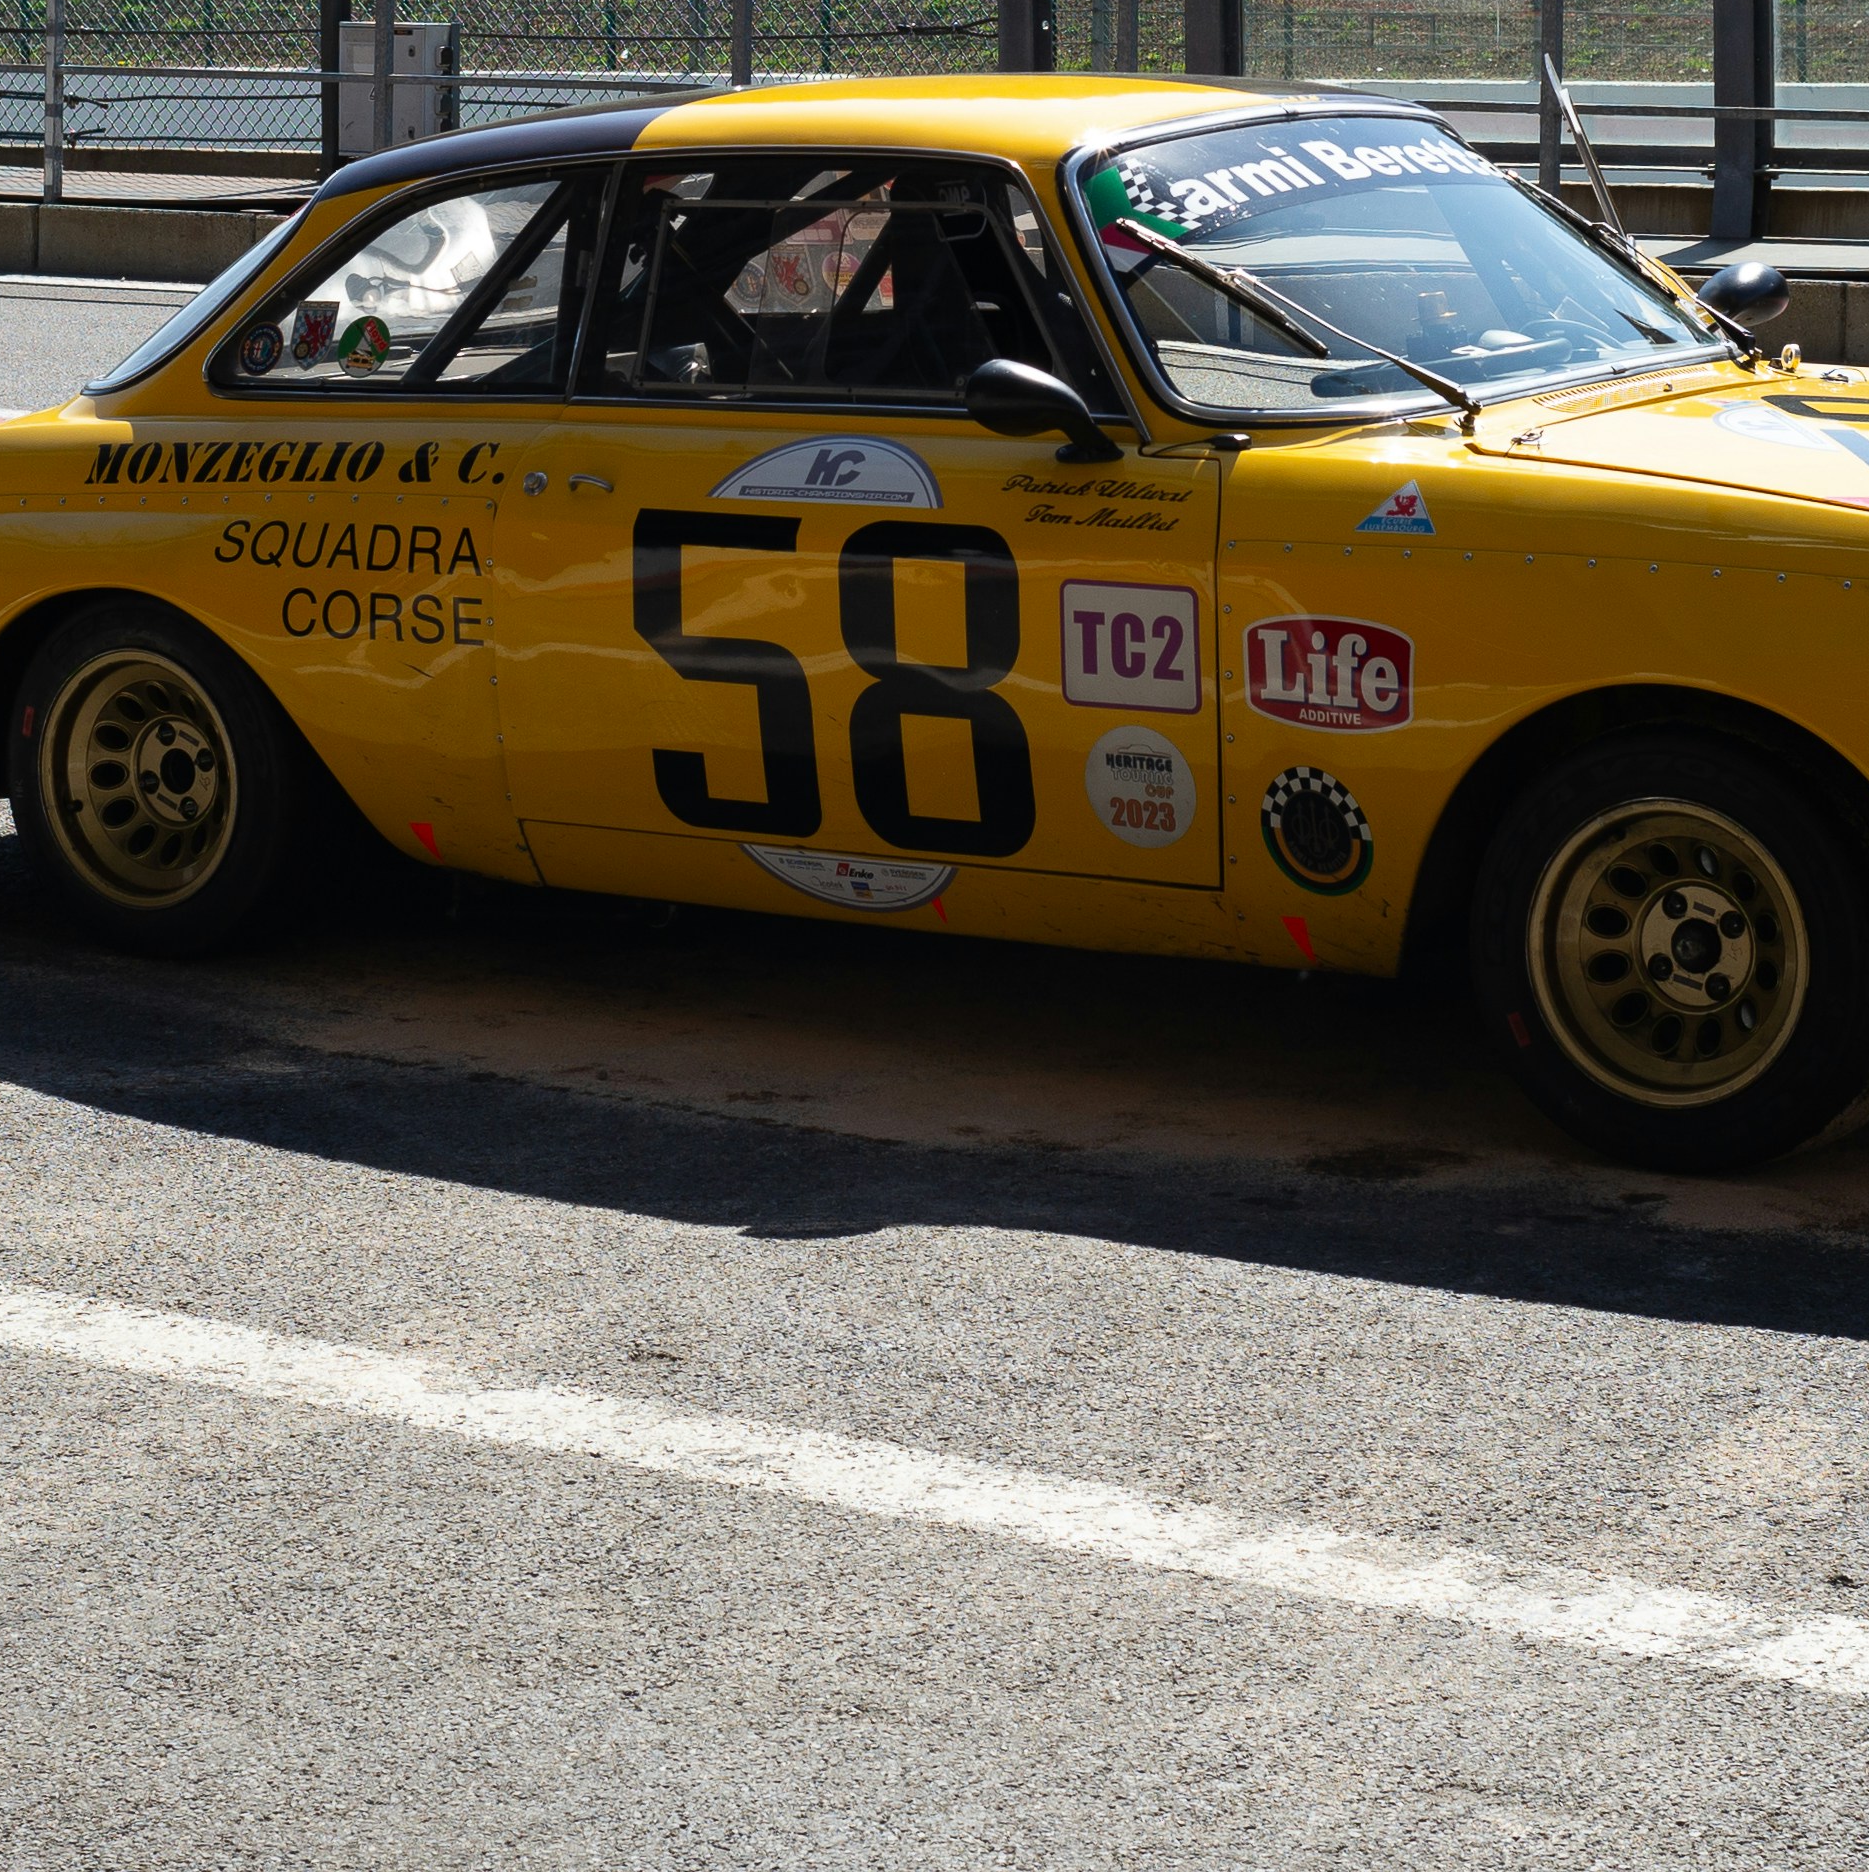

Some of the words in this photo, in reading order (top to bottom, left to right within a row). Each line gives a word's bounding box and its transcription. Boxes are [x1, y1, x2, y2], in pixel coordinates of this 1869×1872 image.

[1168, 146, 1326, 218] armi
[1298, 137, 1506, 183] Beretta
[84, 440, 385, 485] MONZEGLIO
[398, 440, 439, 485] &
[457, 441, 507, 486] C.
[744, 486, 910, 502] HISTORIC-CHAMPIONSHIP.COM
[1001, 473, 1096, 497] Patrick
[1024, 503, 1073, 523] Tom
[213, 519, 485, 577] SQUADRA
[281, 587, 486, 647] CORSE
[1073, 609, 1185, 682] TC2
[631, 508, 1036, 858] 58
[1257, 628, 1400, 713] Life
[1298, 707, 1363, 726] ADDITIVE
[1105, 752, 1174, 774] HERITAGE
[1110, 766, 1175, 787] TOURING
[1109, 795, 1177, 834] 2023
[848, 867, 876, 881] Enke
